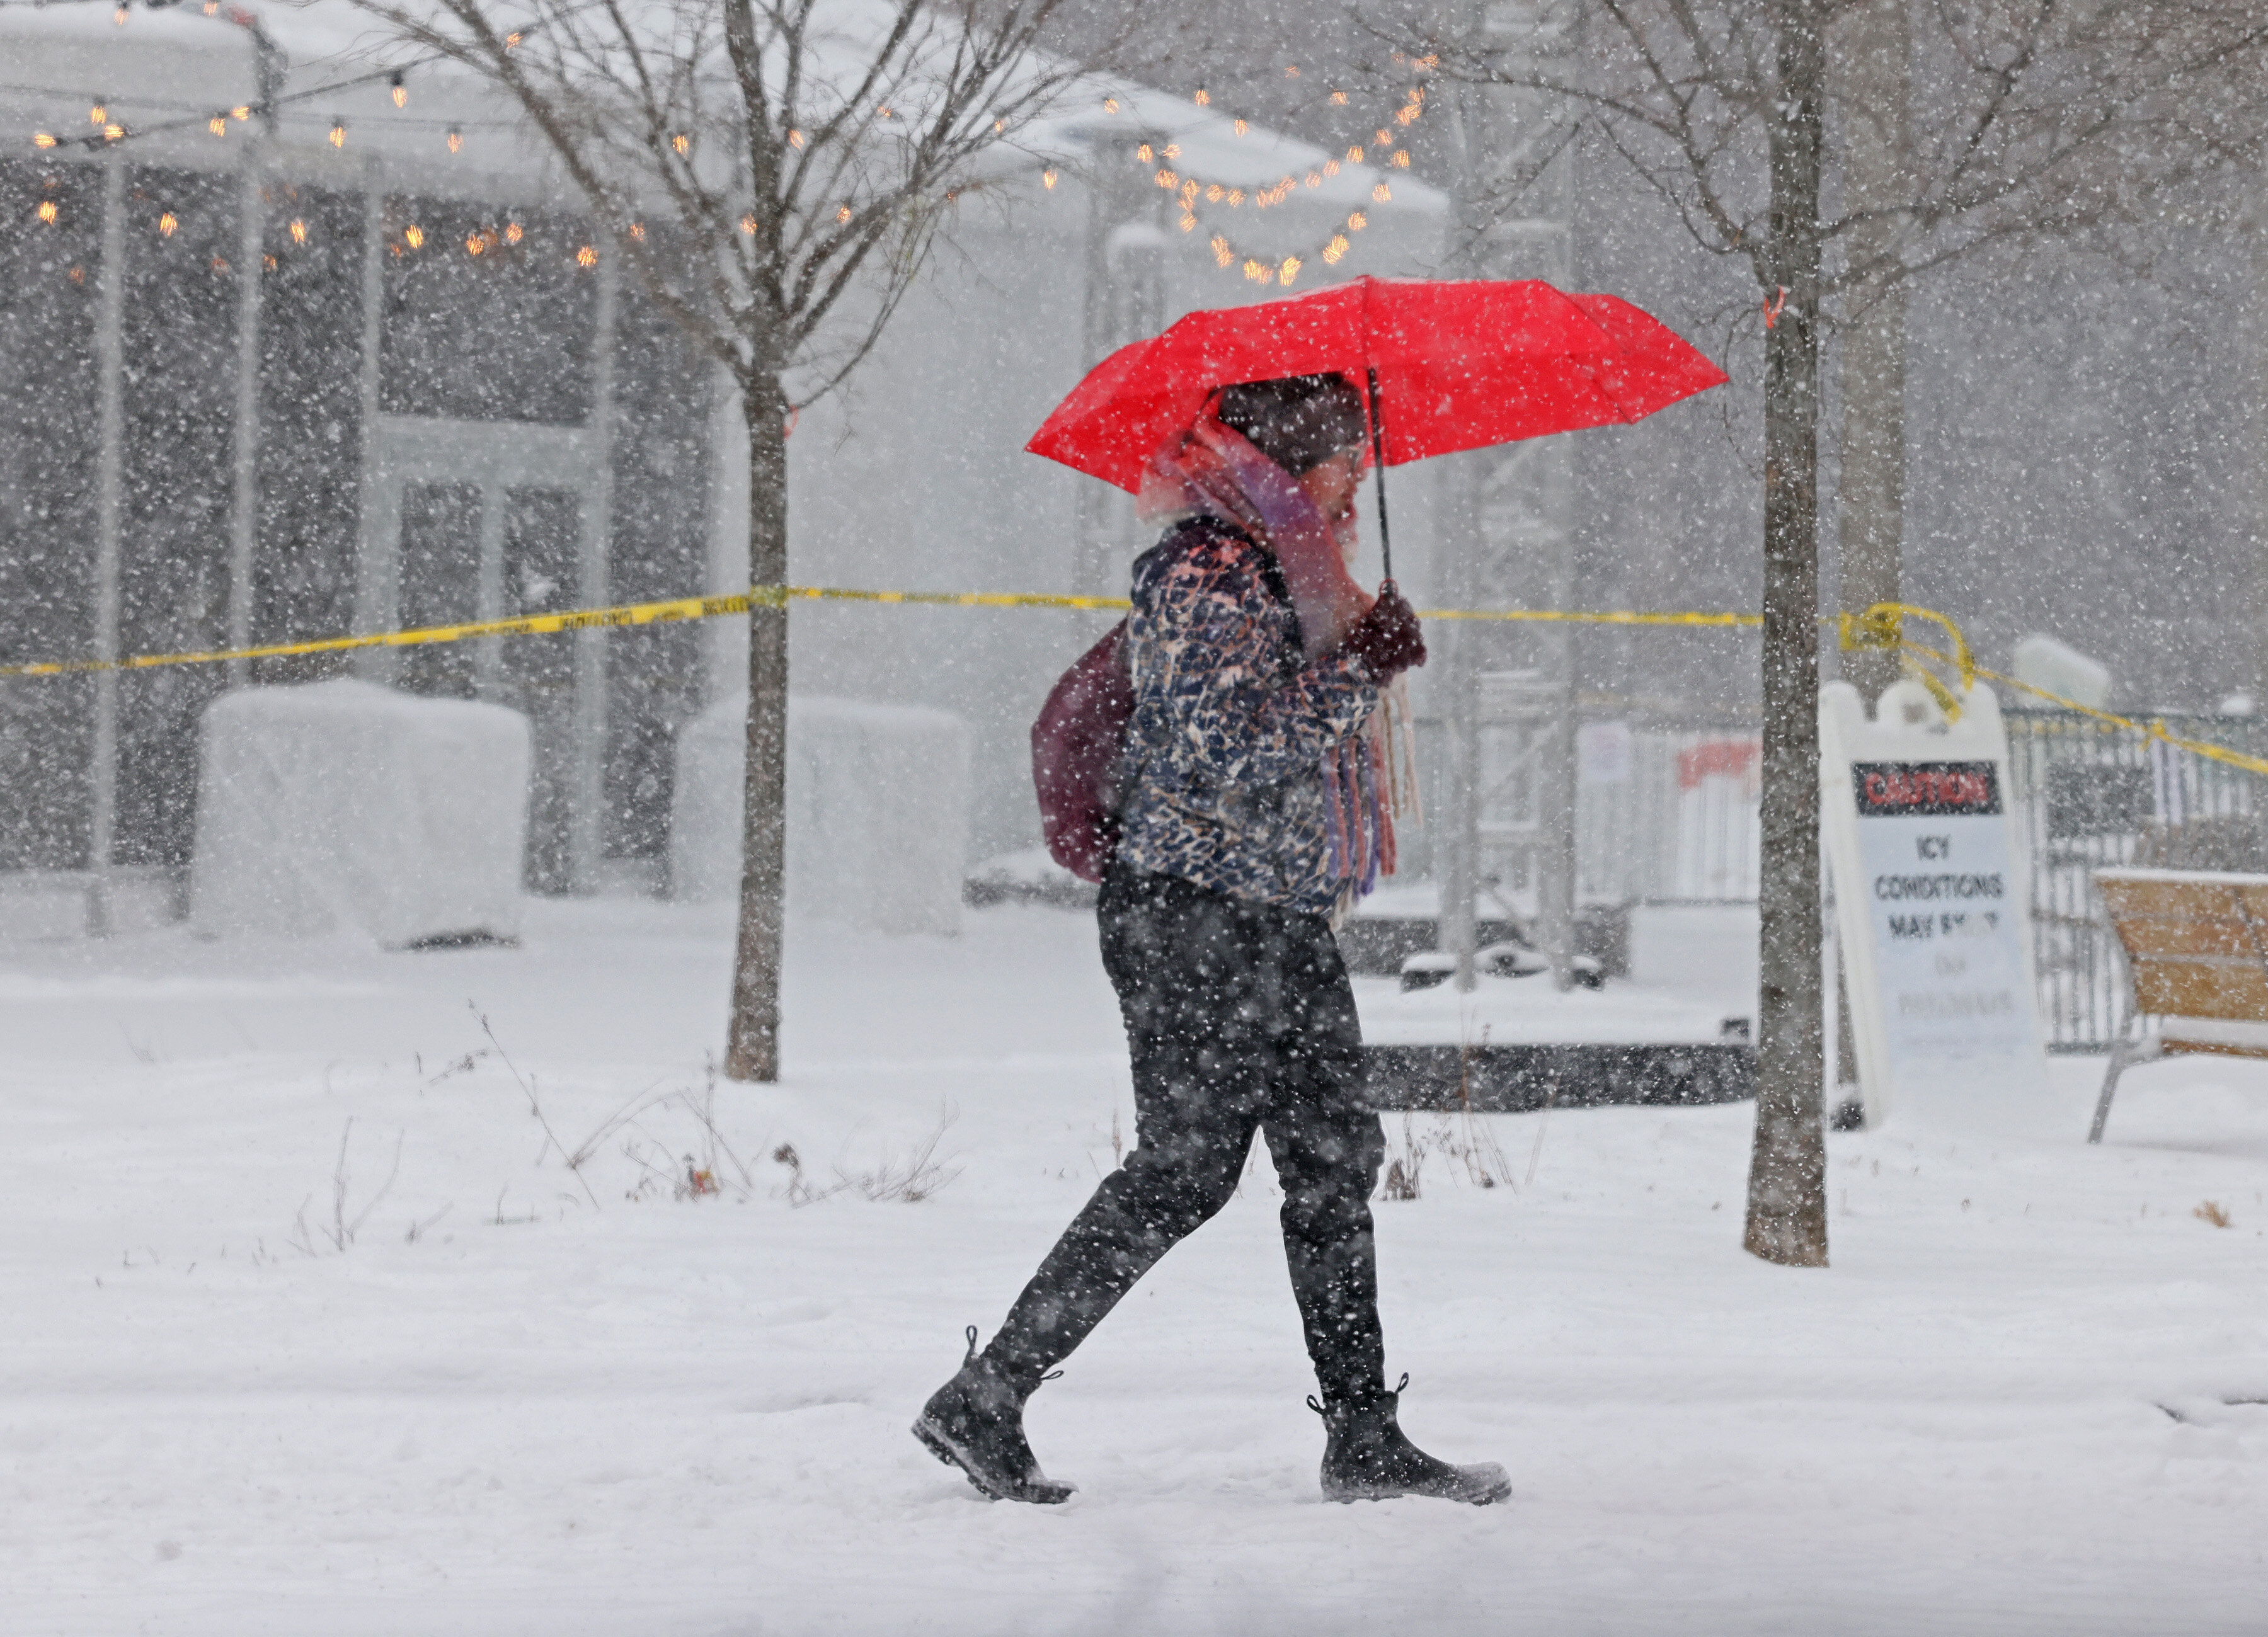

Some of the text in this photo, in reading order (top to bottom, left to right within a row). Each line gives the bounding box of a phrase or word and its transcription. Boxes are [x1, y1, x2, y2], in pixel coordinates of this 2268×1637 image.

[1865, 772, 1988, 806] CAUTION
[1916, 833, 1951, 860] ICY
[1875, 872, 2003, 900] CONDITIONS
[1889, 913, 1933, 939] MAY
